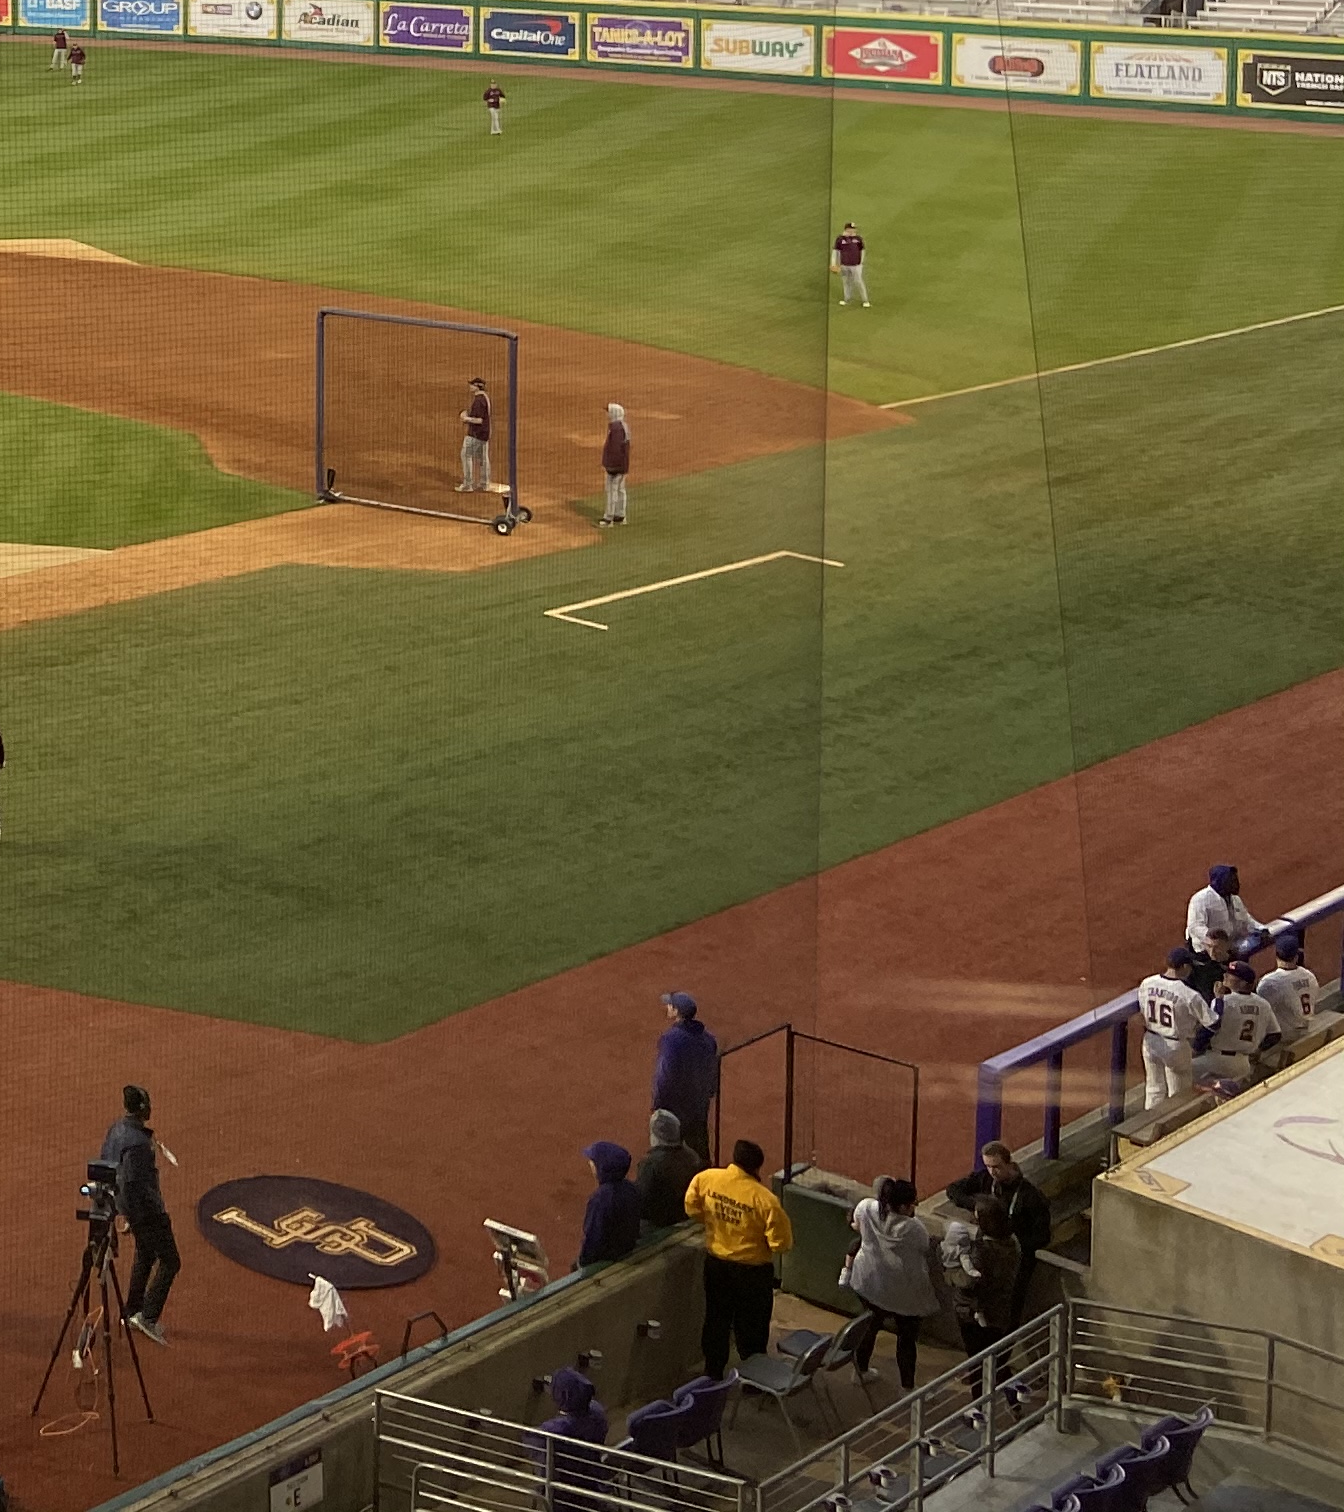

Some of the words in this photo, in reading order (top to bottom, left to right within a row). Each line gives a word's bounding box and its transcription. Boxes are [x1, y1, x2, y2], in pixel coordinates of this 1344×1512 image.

[102, 0, 178, 15] GROUP
[297, 11, 359, 28] Acadian
[383, 14, 408, 35] La
[410, 16, 470, 37] Carreta
[710, 37, 804, 58] SUBWAY
[1115, 61, 1202, 83] FLATLAND
[1262, 70, 1285, 86] NTS
[1295, 72, 1344, 84] NATION
[1148, 999, 1172, 1028] 16
[1301, 993, 1311, 1015] 6
[1239, 1019, 1255, 1042] 2
[212, 1206, 417, 1266] LSU
